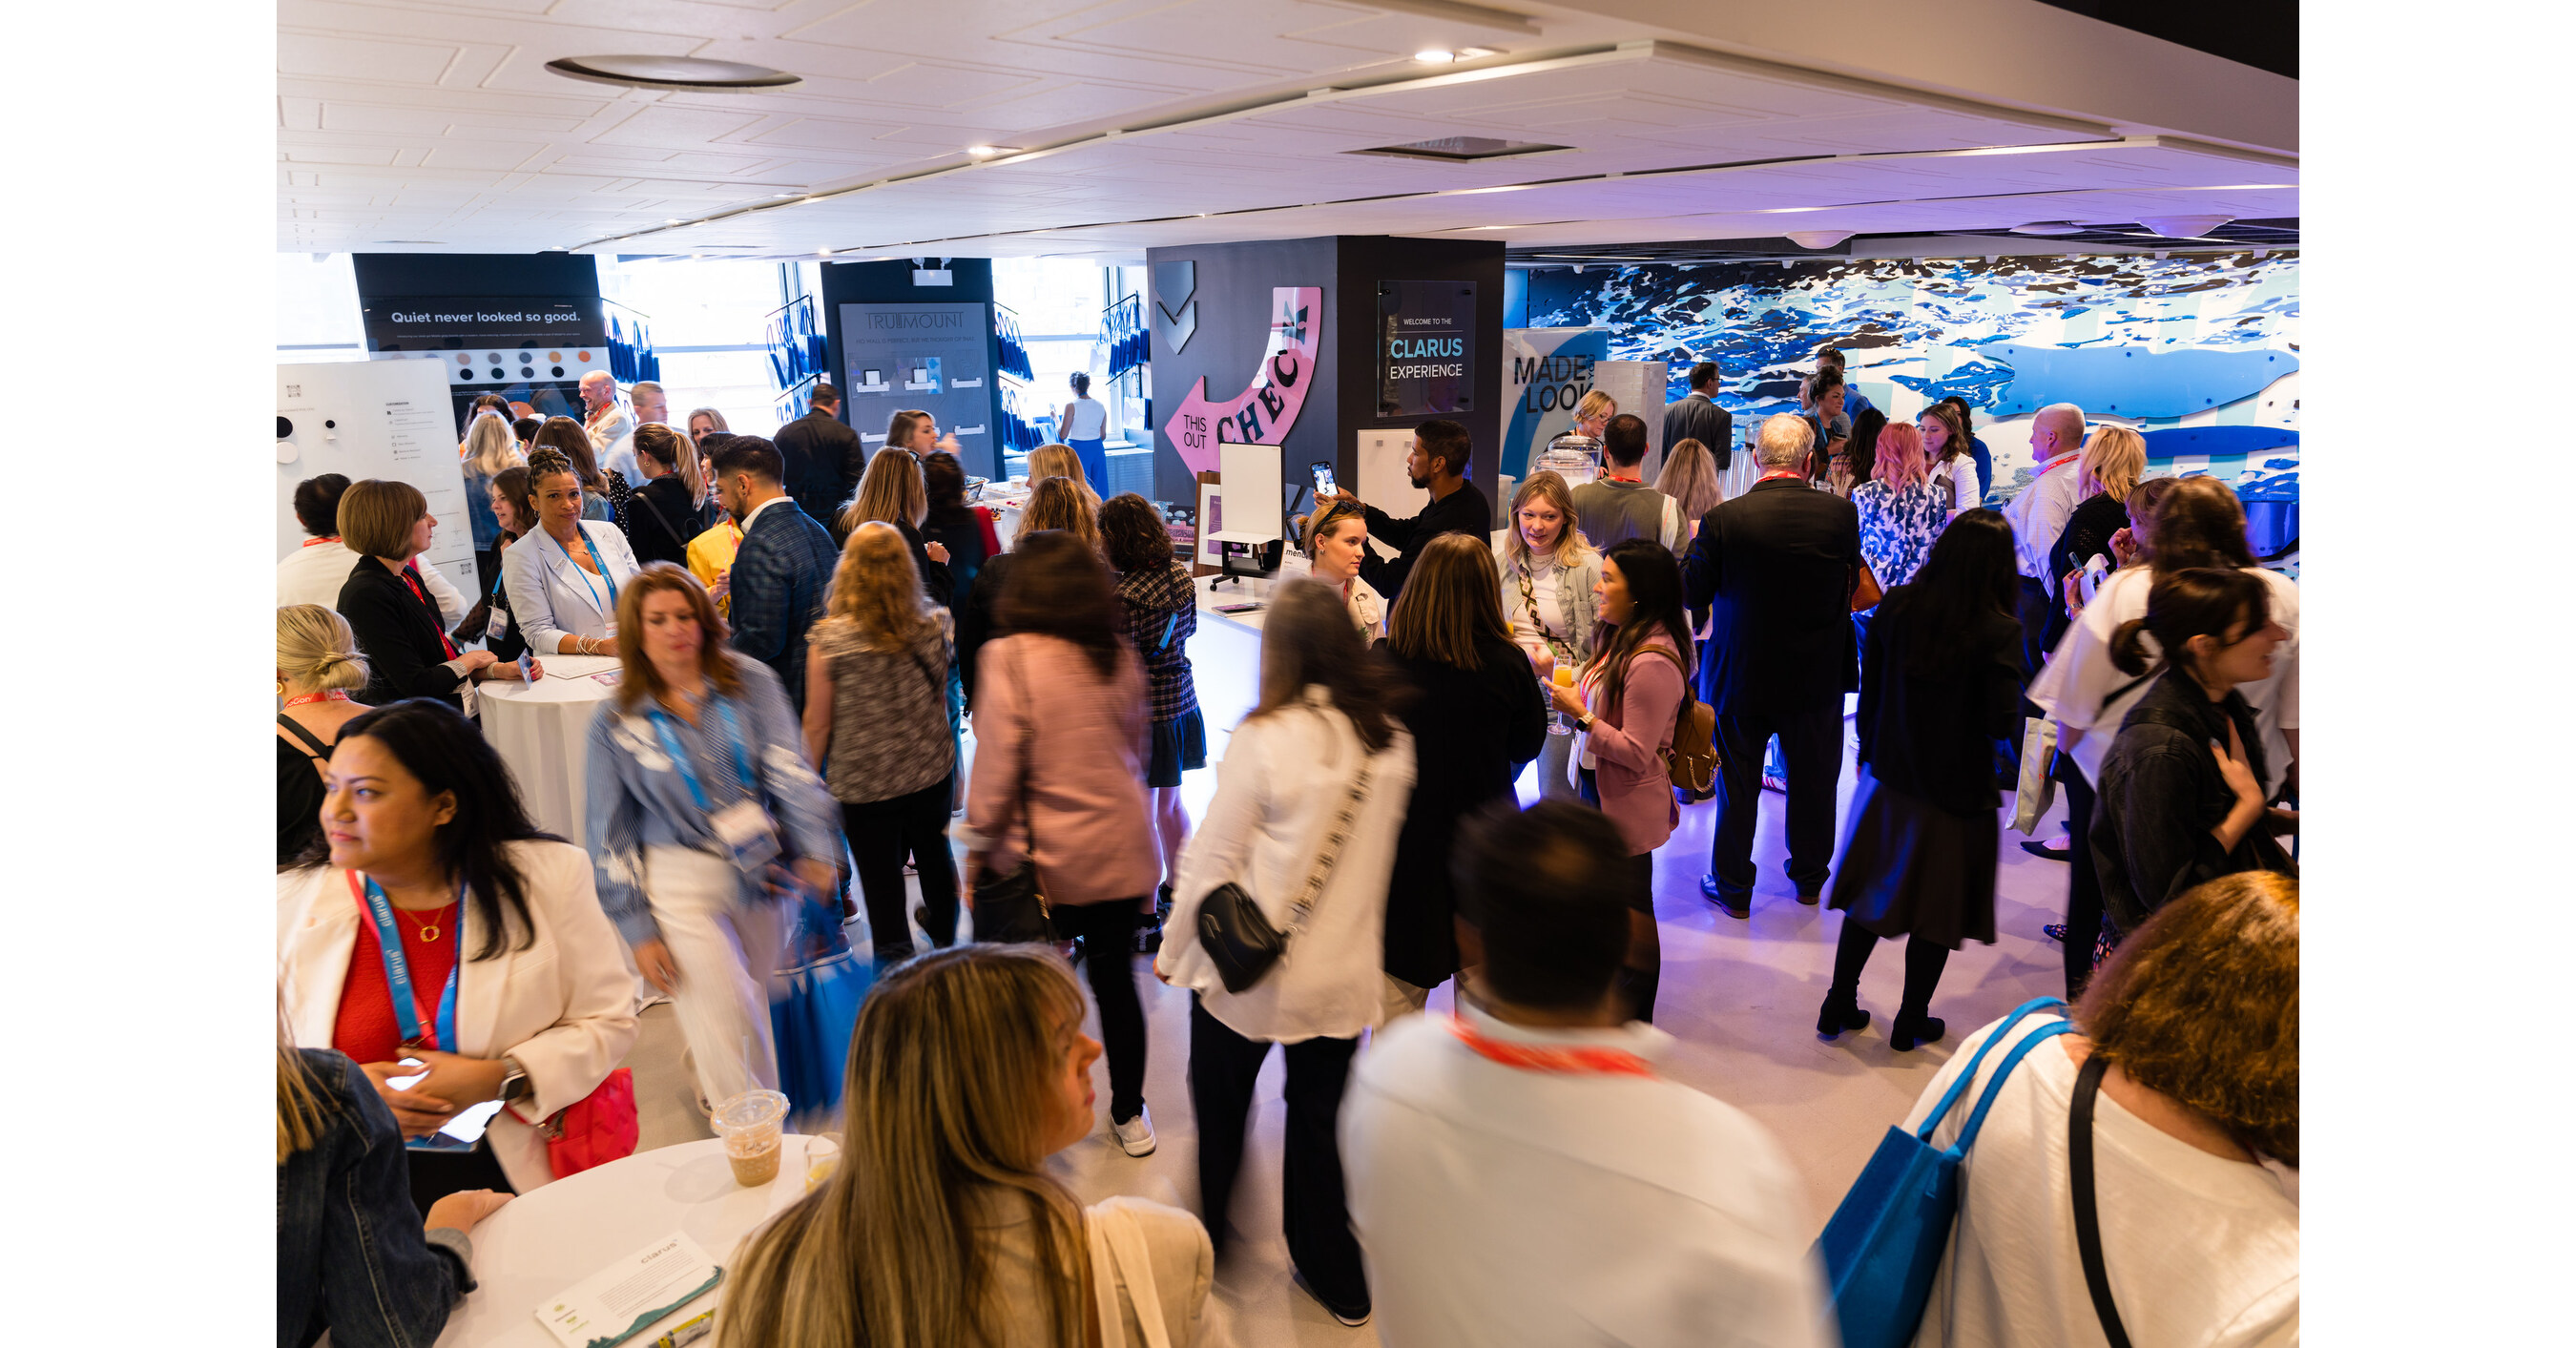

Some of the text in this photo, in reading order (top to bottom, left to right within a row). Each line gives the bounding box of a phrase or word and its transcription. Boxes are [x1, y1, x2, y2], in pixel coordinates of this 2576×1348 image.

[391, 311, 581, 324] Quiet never looked so good.
[1390, 338, 1464, 359] CLARUS
[1216, 301, 1309, 445] CHECK
[1390, 363, 1463, 380] EXPERIENCE
[1514, 355, 1587, 384] MADE
[1183, 414, 1207, 432] THIS
[1184, 431, 1207, 449] OUT
[371, 894, 393, 927] clarus
[387, 949, 407, 985] clarus
[640, 1241, 677, 1264] clarus
